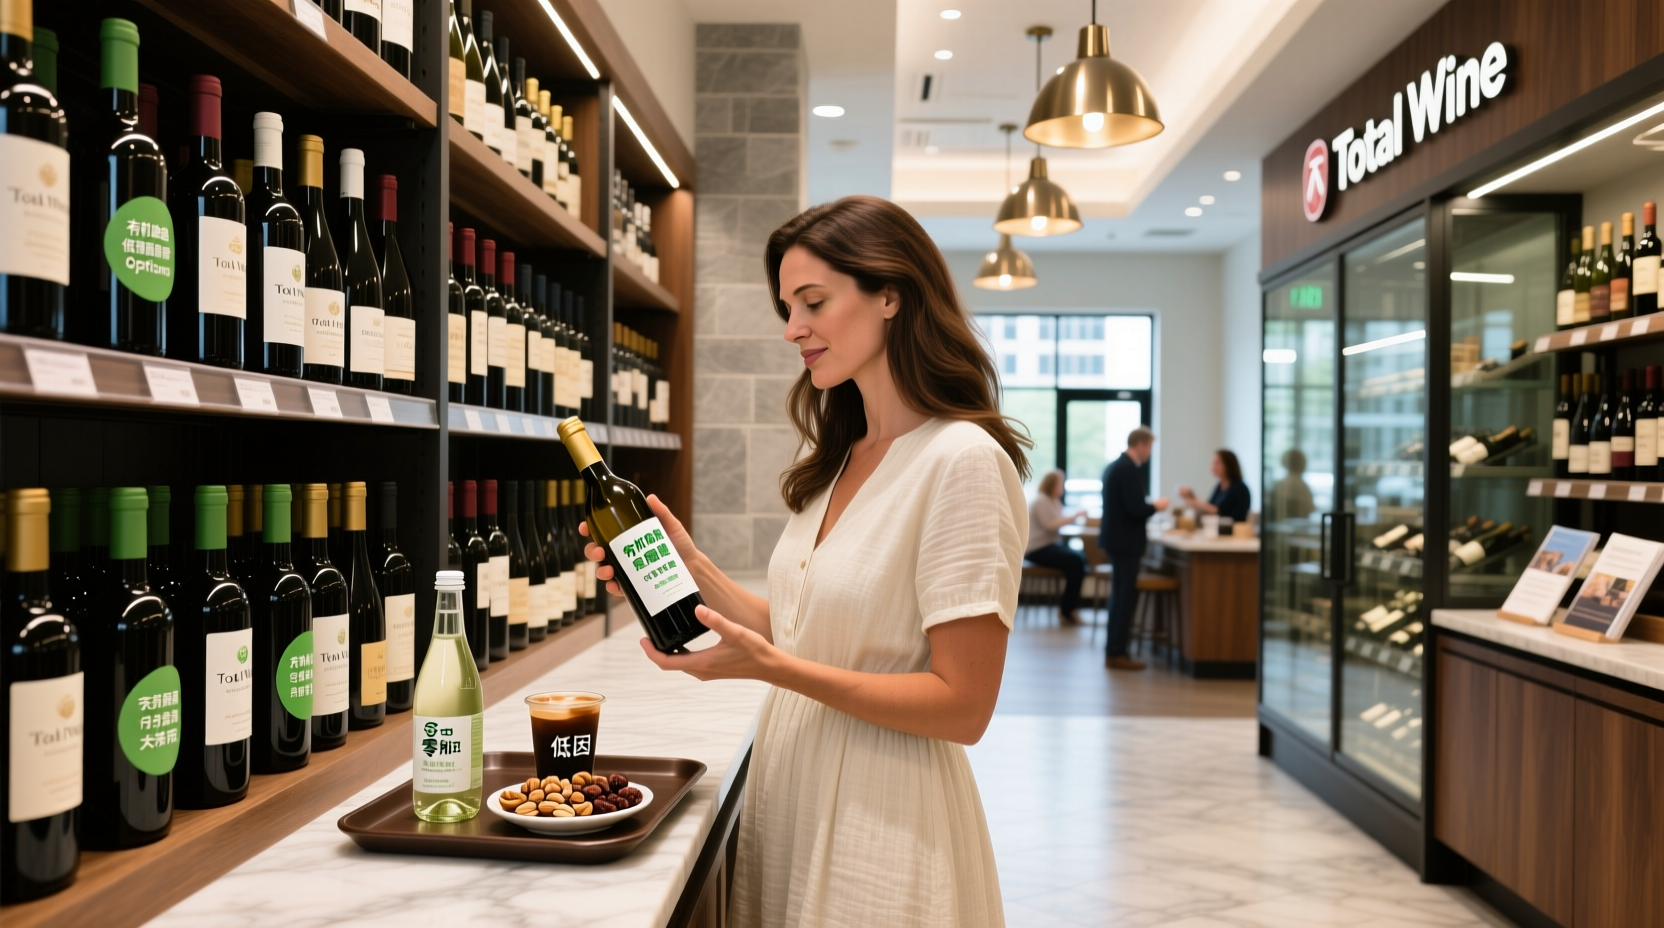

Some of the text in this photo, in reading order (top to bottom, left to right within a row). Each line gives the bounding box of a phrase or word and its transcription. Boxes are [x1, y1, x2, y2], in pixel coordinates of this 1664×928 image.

[1332, 41, 1507, 191] Total Wine
[551, 734, 591, 758] 低因
